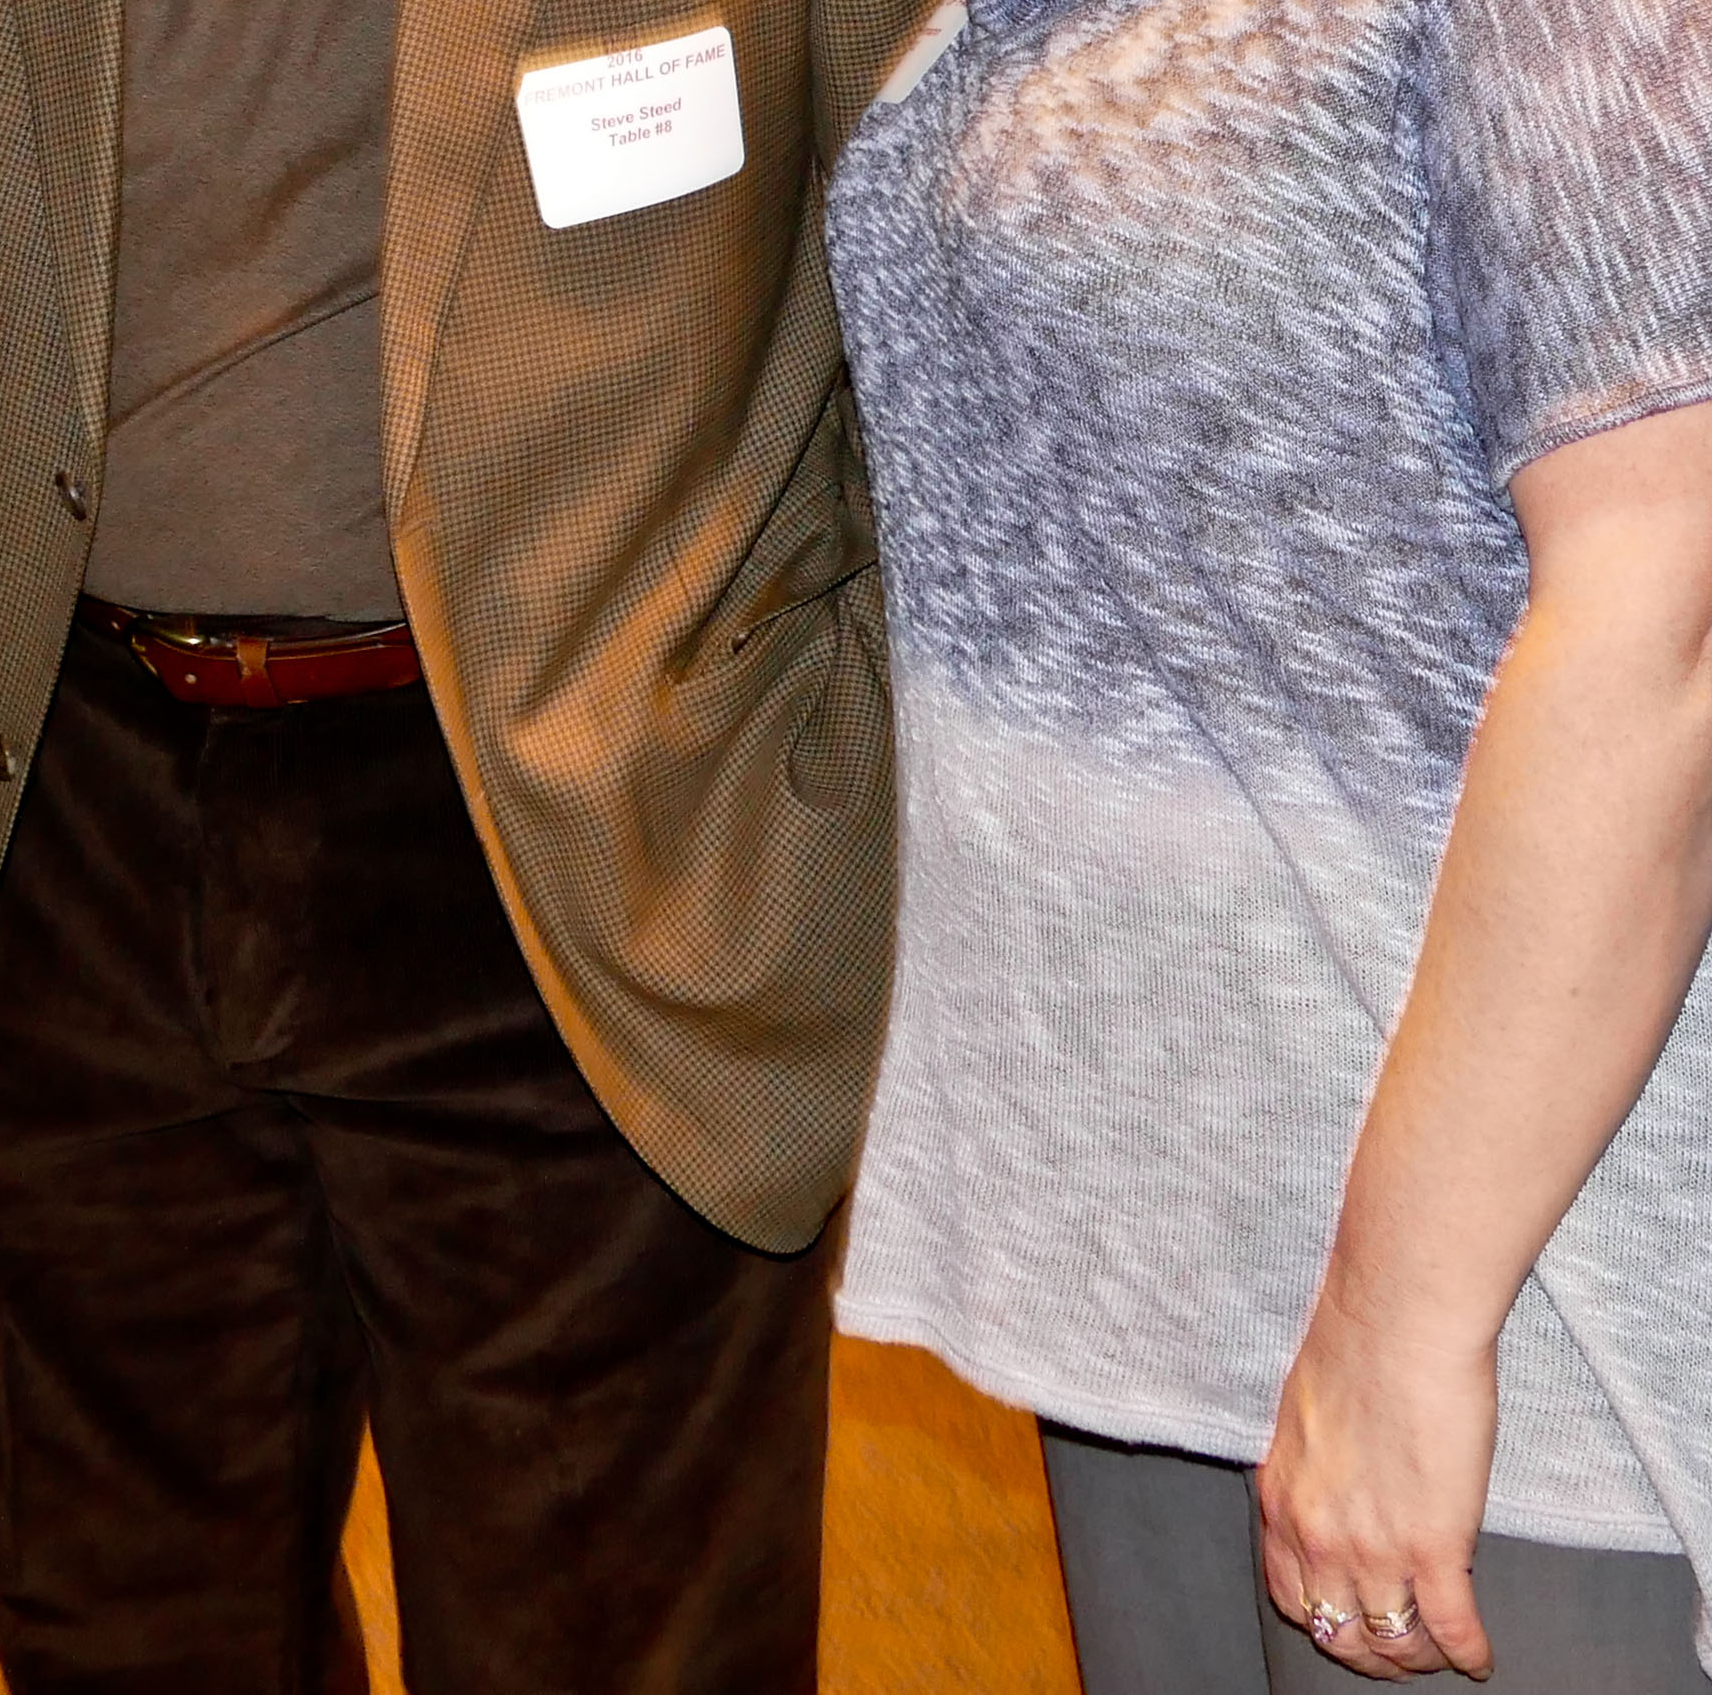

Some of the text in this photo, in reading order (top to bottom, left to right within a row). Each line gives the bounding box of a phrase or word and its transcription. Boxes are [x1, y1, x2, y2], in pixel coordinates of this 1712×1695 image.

[606, 49, 643, 68] 2016
[524, 44, 726, 107] FREMONT HALL OF FAME
[591, 98, 682, 131] Steve Steed
[609, 120, 672, 147] Table #8
